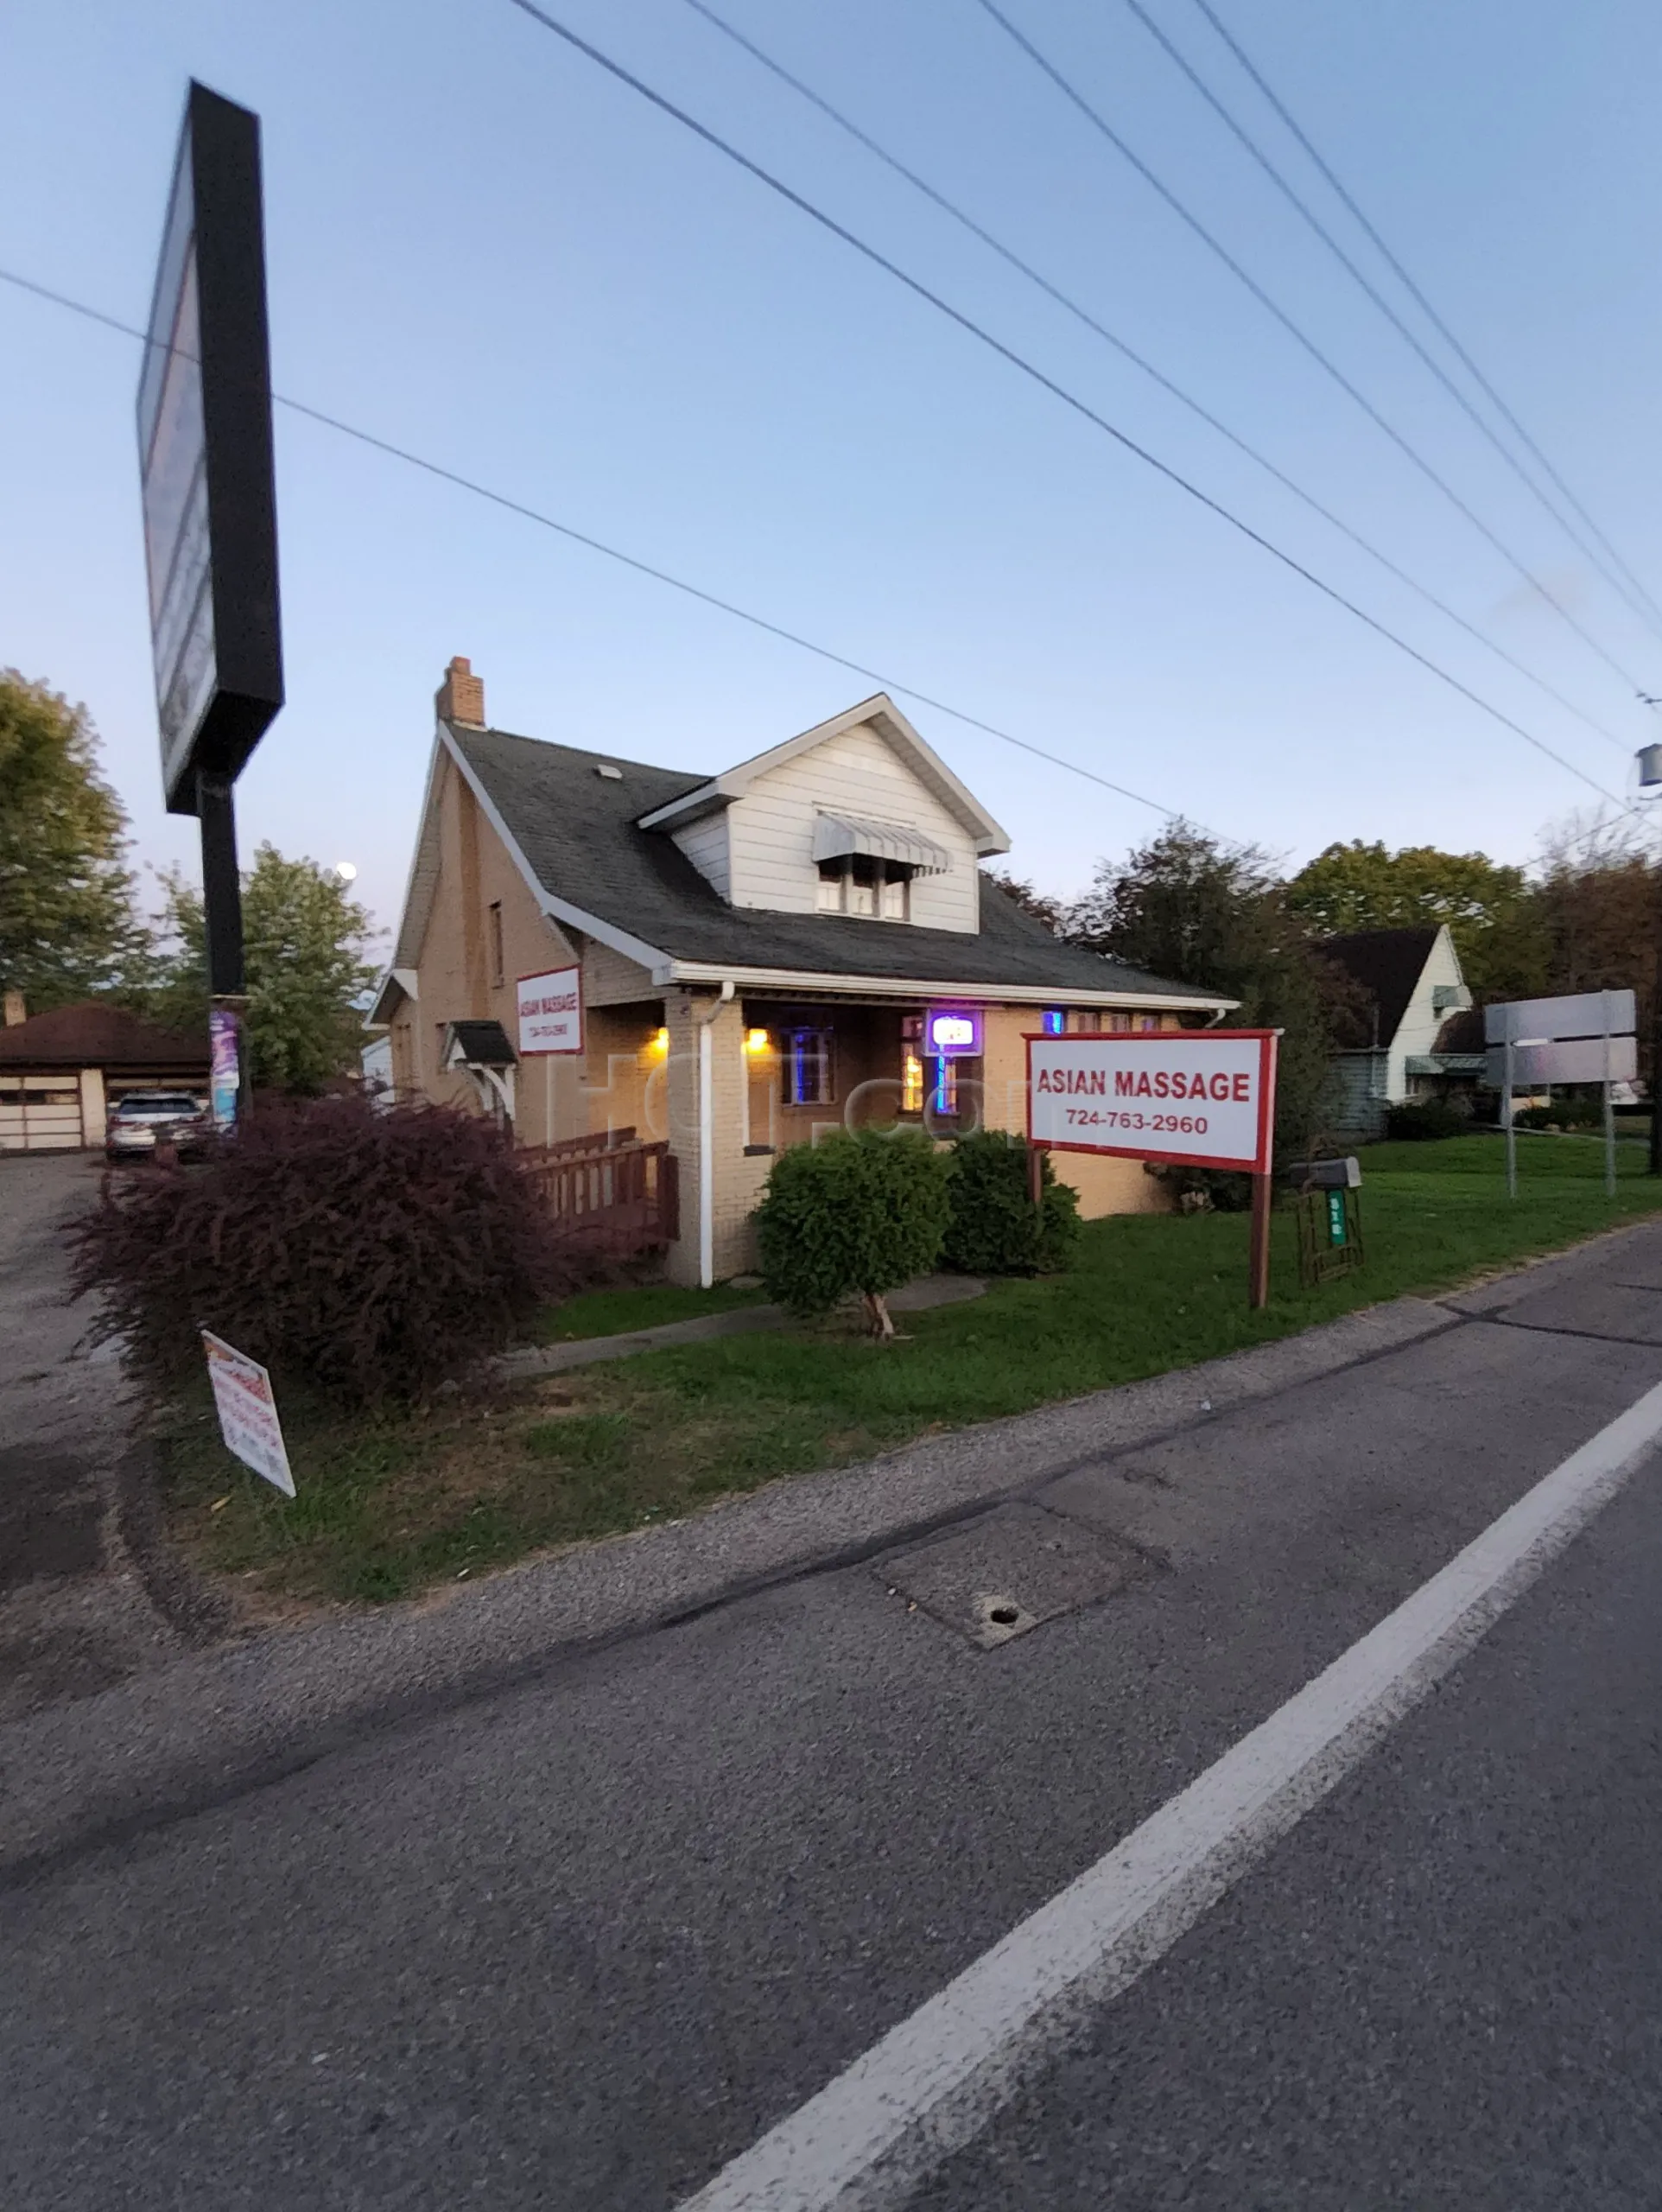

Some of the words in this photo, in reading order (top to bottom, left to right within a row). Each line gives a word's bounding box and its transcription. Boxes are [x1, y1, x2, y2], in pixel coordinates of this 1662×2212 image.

[1037, 1068, 1107, 1096] ASIAN
[1114, 1070, 1251, 1103] MASSAGE
[1065, 1109, 1208, 1135] 724-763-2960
